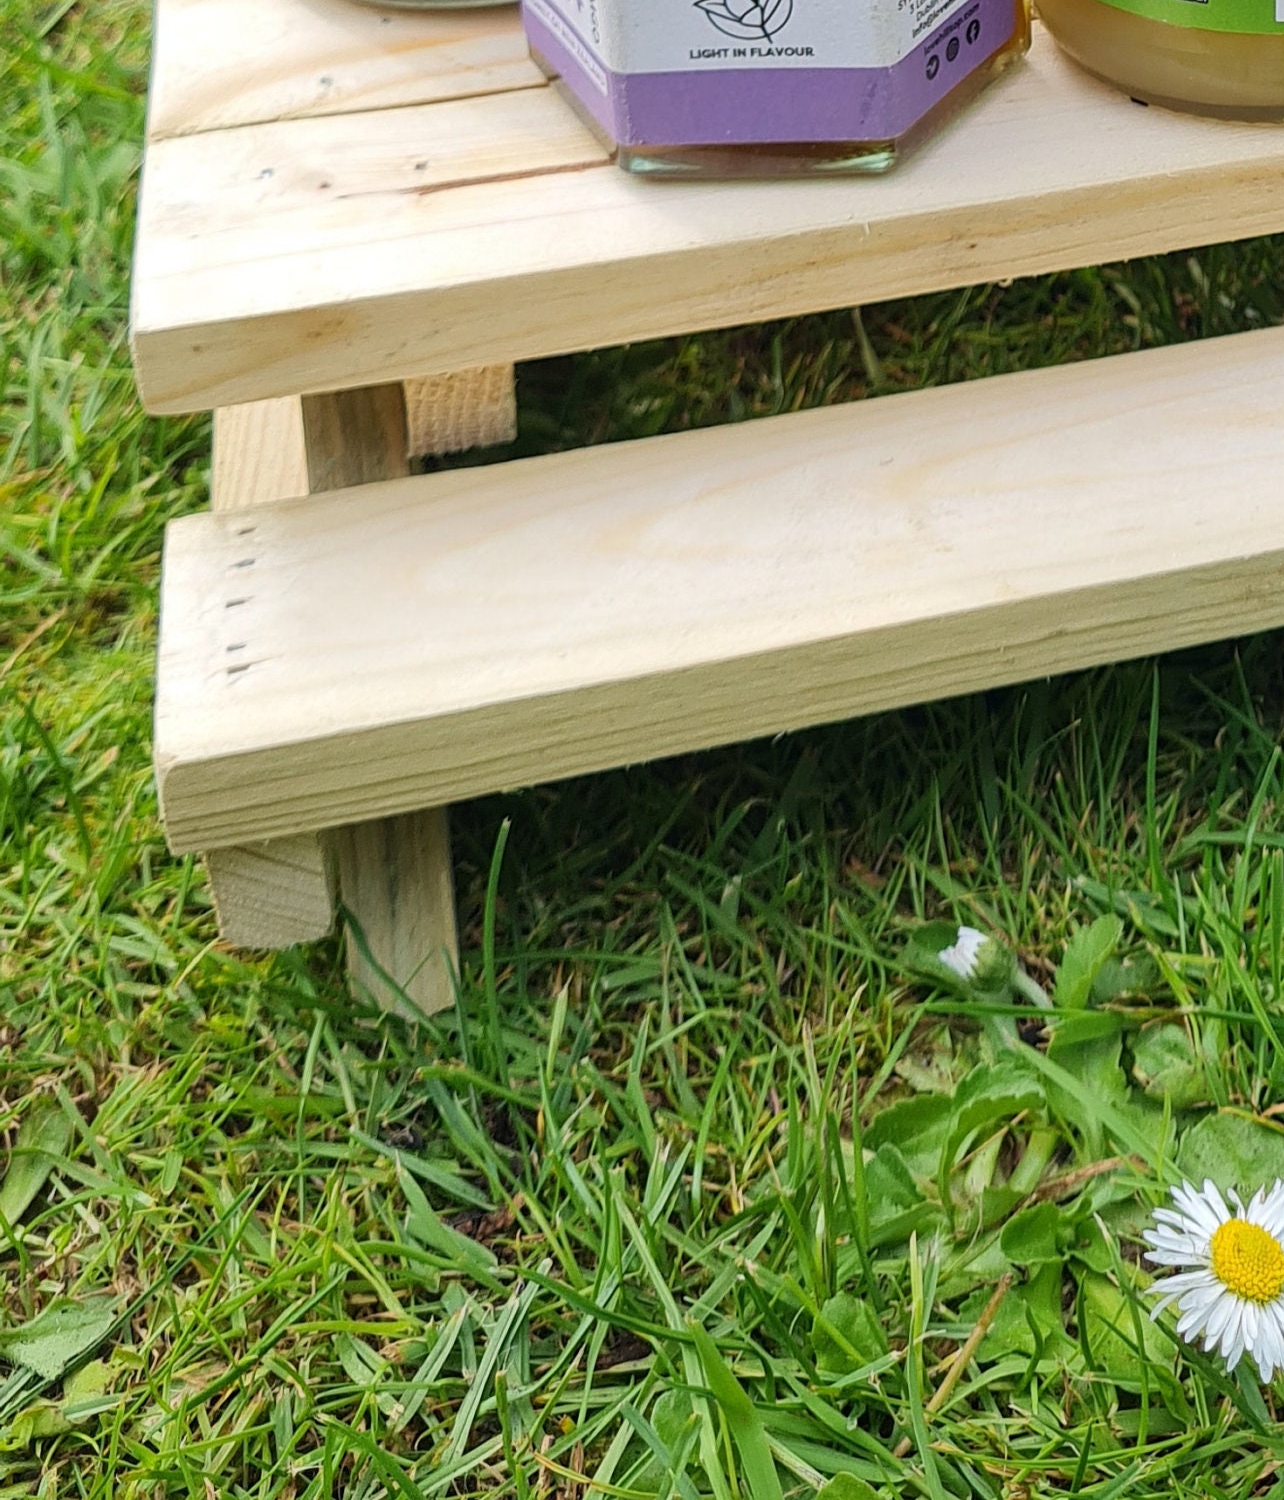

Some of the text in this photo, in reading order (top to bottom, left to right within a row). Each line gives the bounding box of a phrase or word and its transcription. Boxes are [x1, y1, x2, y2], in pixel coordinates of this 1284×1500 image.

[690, 47, 814, 59] LIGHT IN FLAVOUR
